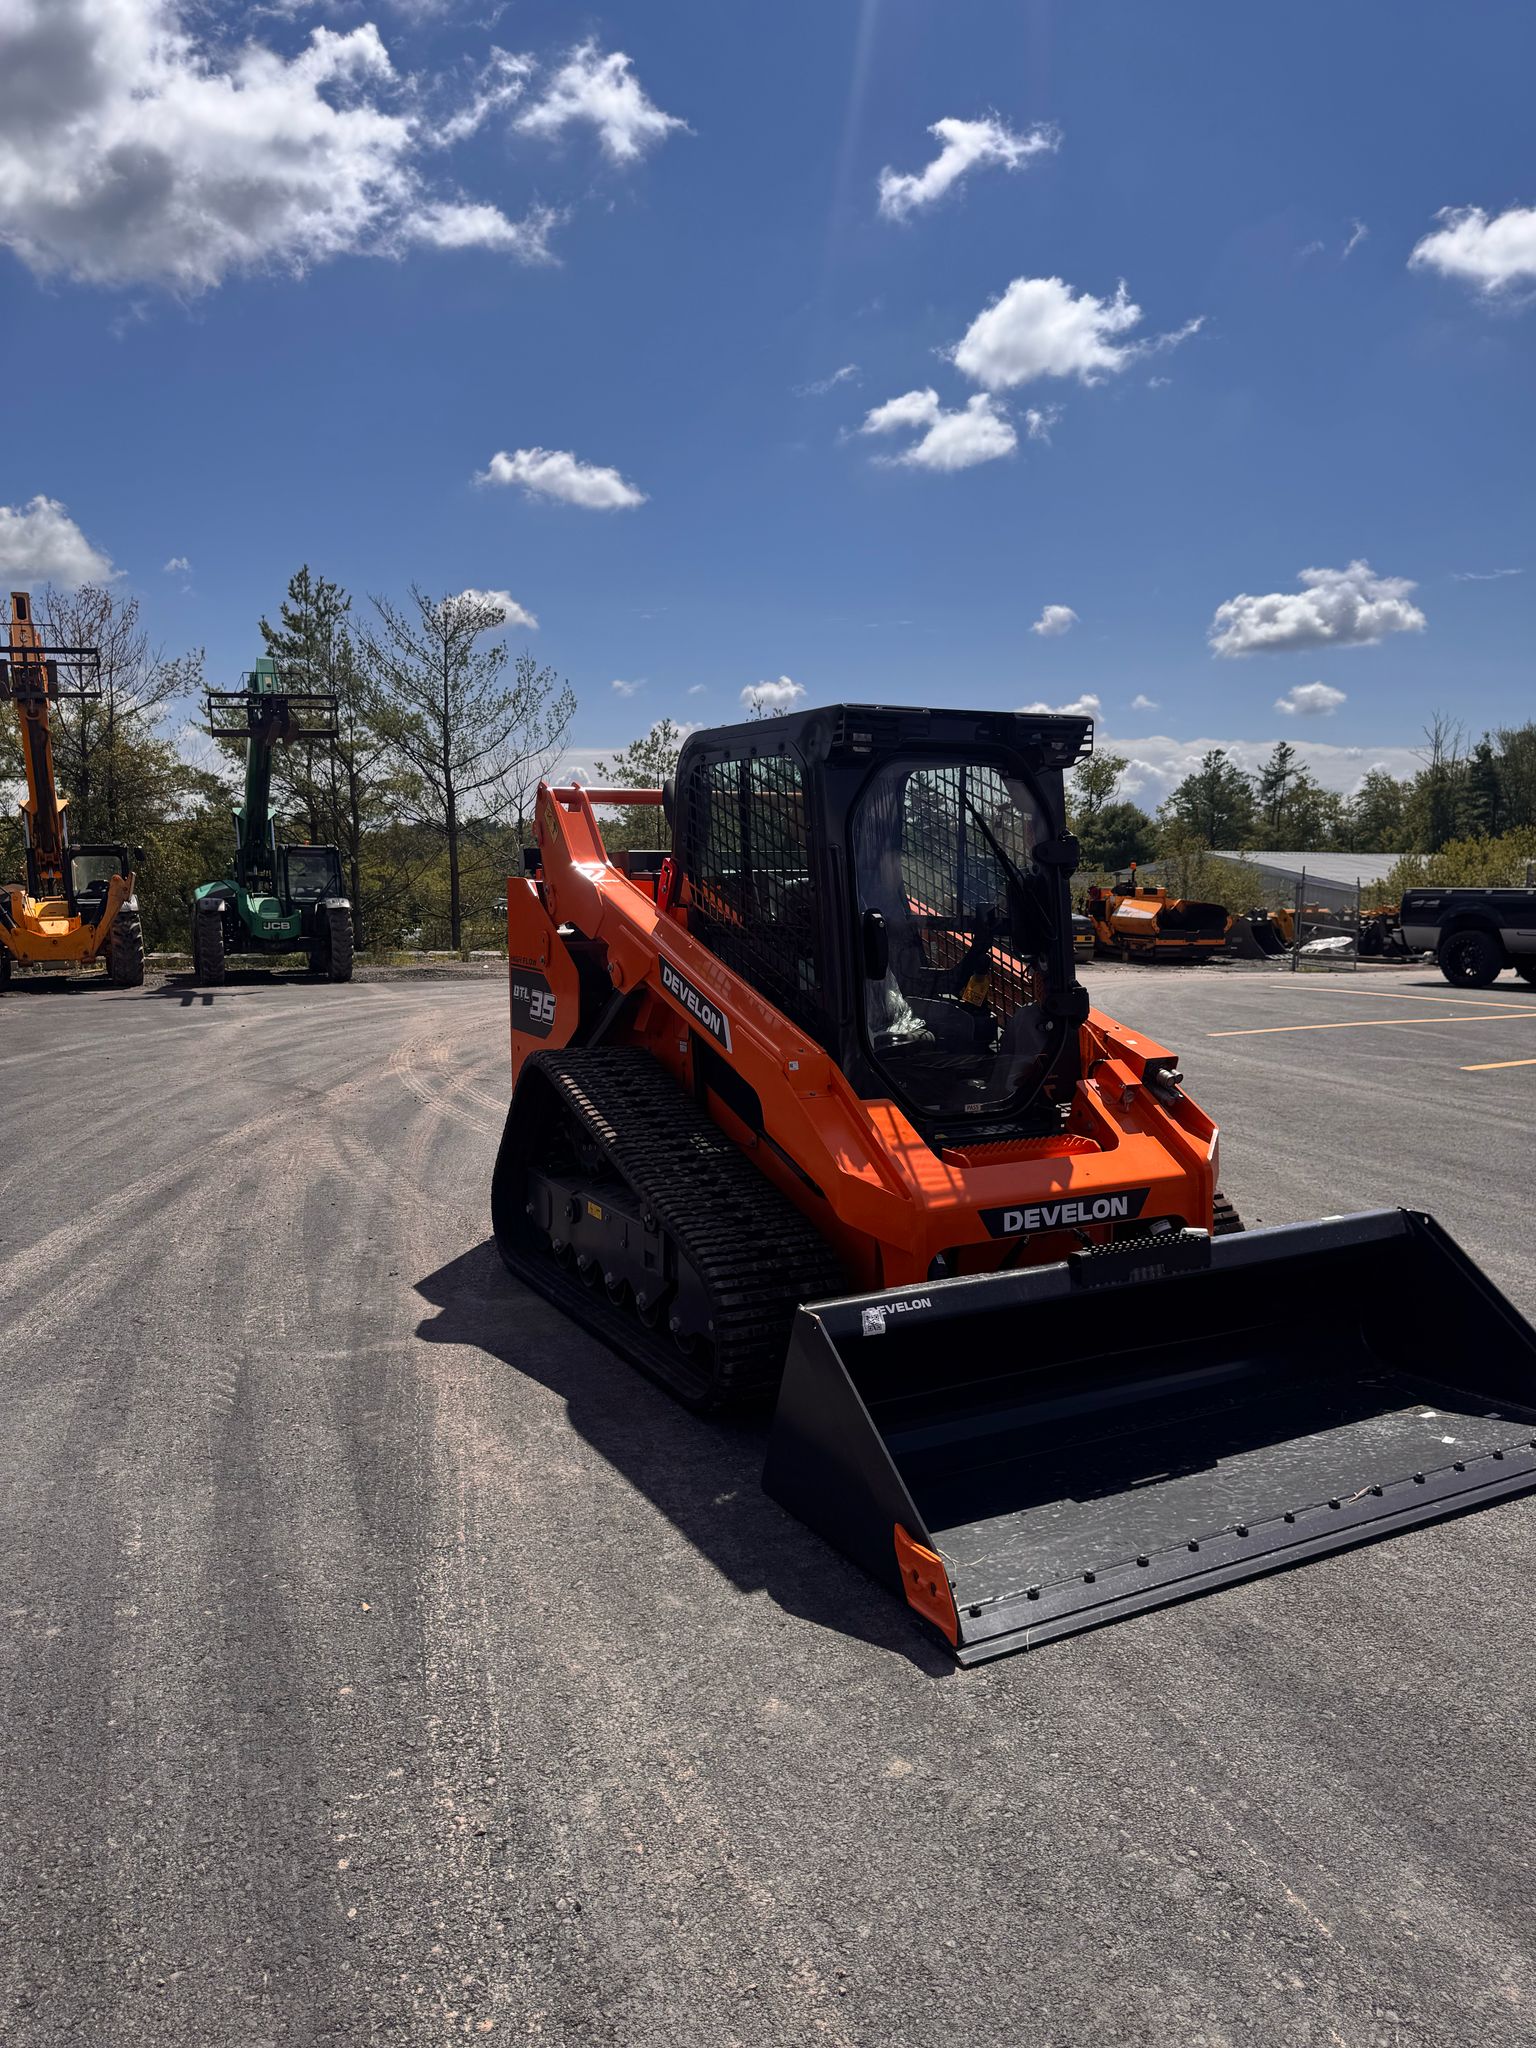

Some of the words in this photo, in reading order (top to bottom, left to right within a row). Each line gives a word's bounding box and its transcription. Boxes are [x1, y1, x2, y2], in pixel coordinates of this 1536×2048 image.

[263, 922, 290, 930] JCB
[513, 985, 531, 1002] DTL
[529, 989, 557, 1025] 35
[662, 966, 721, 1035] DEVELON
[1003, 1196, 1128, 1232] DEVELON
[866, 1298, 932, 1316] EVELON
